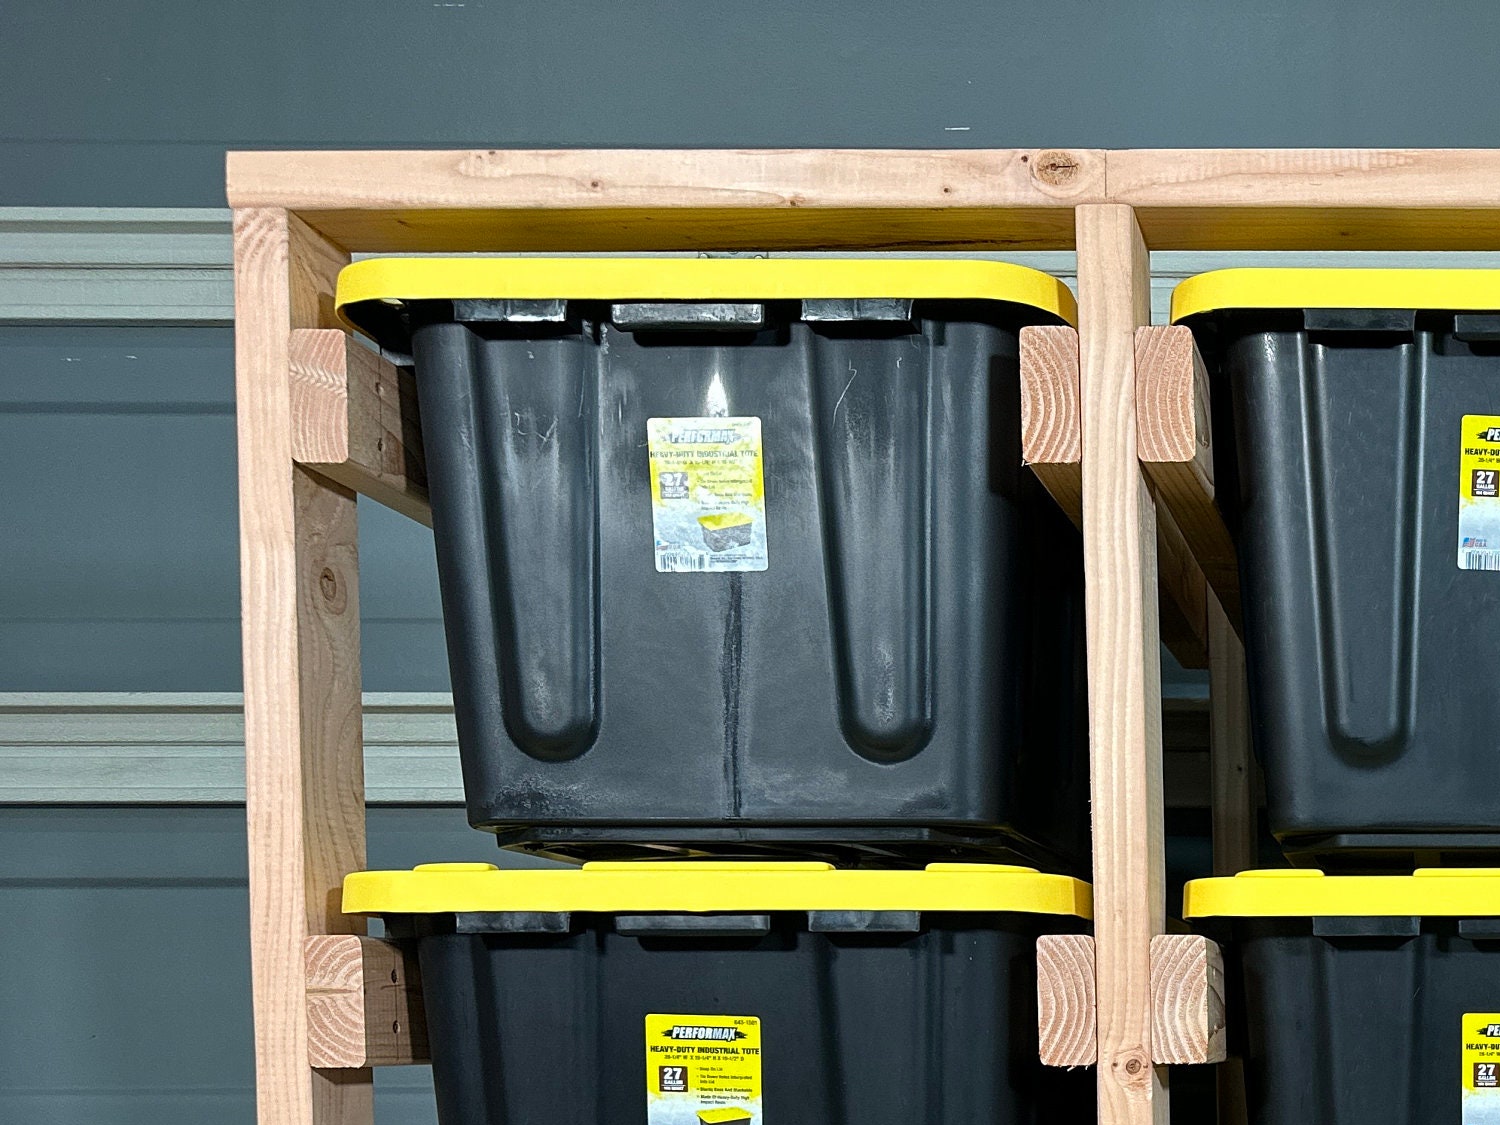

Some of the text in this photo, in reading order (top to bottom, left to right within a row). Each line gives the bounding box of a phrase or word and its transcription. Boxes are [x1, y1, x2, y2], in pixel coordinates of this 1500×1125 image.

[1477, 471, 1494, 484] 27
[672, 1026, 736, 1041] PERFORMAX
[664, 1067, 682, 1080] 27
[1478, 1064, 1495, 1075] 27
